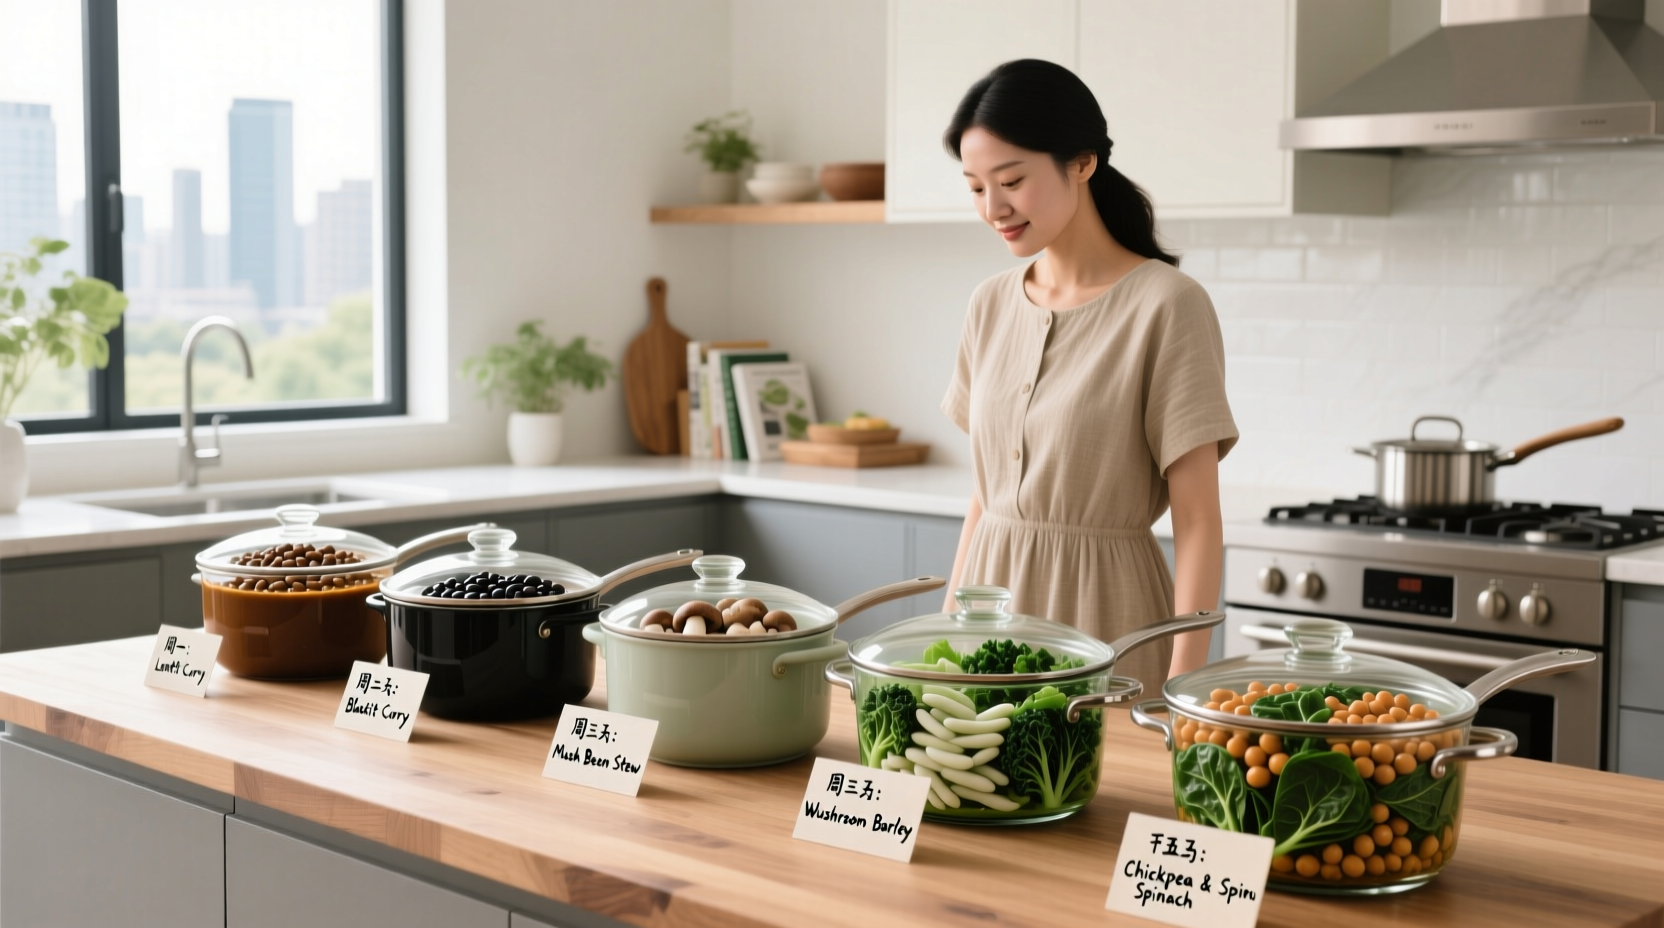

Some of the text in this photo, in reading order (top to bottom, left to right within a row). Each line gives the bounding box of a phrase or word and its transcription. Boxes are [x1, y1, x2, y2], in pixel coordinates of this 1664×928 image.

[612, 754, 641, 775] Stew
[872, 813, 912, 844] Barley
[1124, 860, 1193, 890] Chickpea
[1200, 873, 1211, 893] &
[1134, 882, 1193, 909] Spinach
